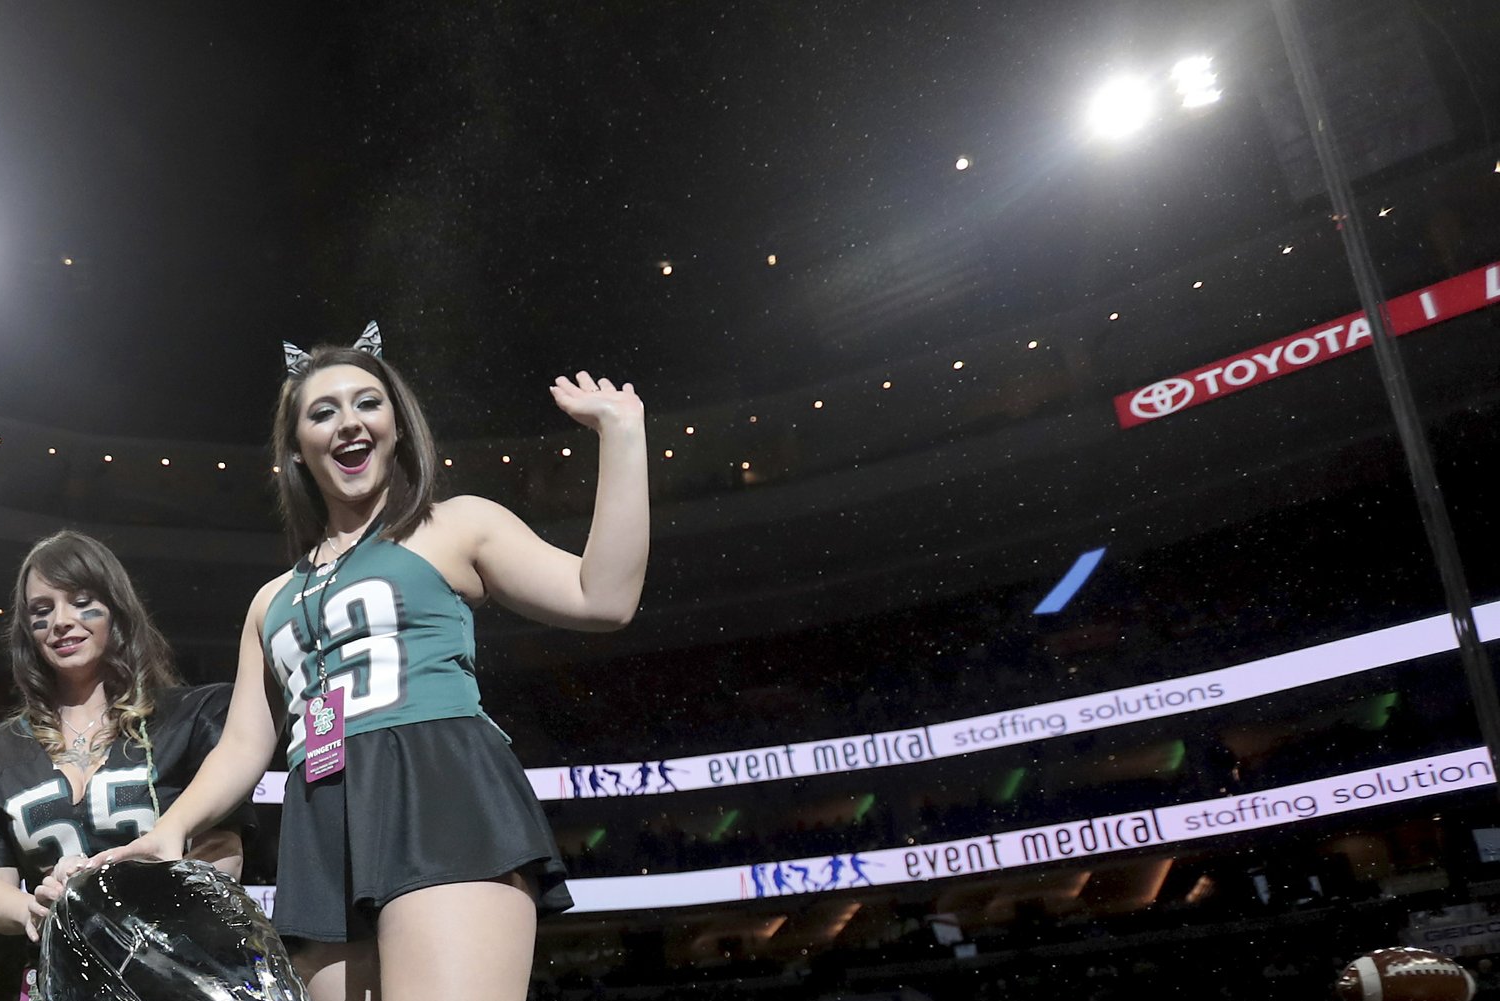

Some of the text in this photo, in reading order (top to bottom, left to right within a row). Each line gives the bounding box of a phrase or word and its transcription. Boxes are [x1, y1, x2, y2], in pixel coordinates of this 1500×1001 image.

[1196, 317, 1373, 395] TOYOTA
[307, 738, 342, 759] WINGETTE
[708, 682, 1225, 785] event medical staffing solutions
[5, 765, 153, 858] 55
[904, 760, 1491, 879] event medical staffing solution
